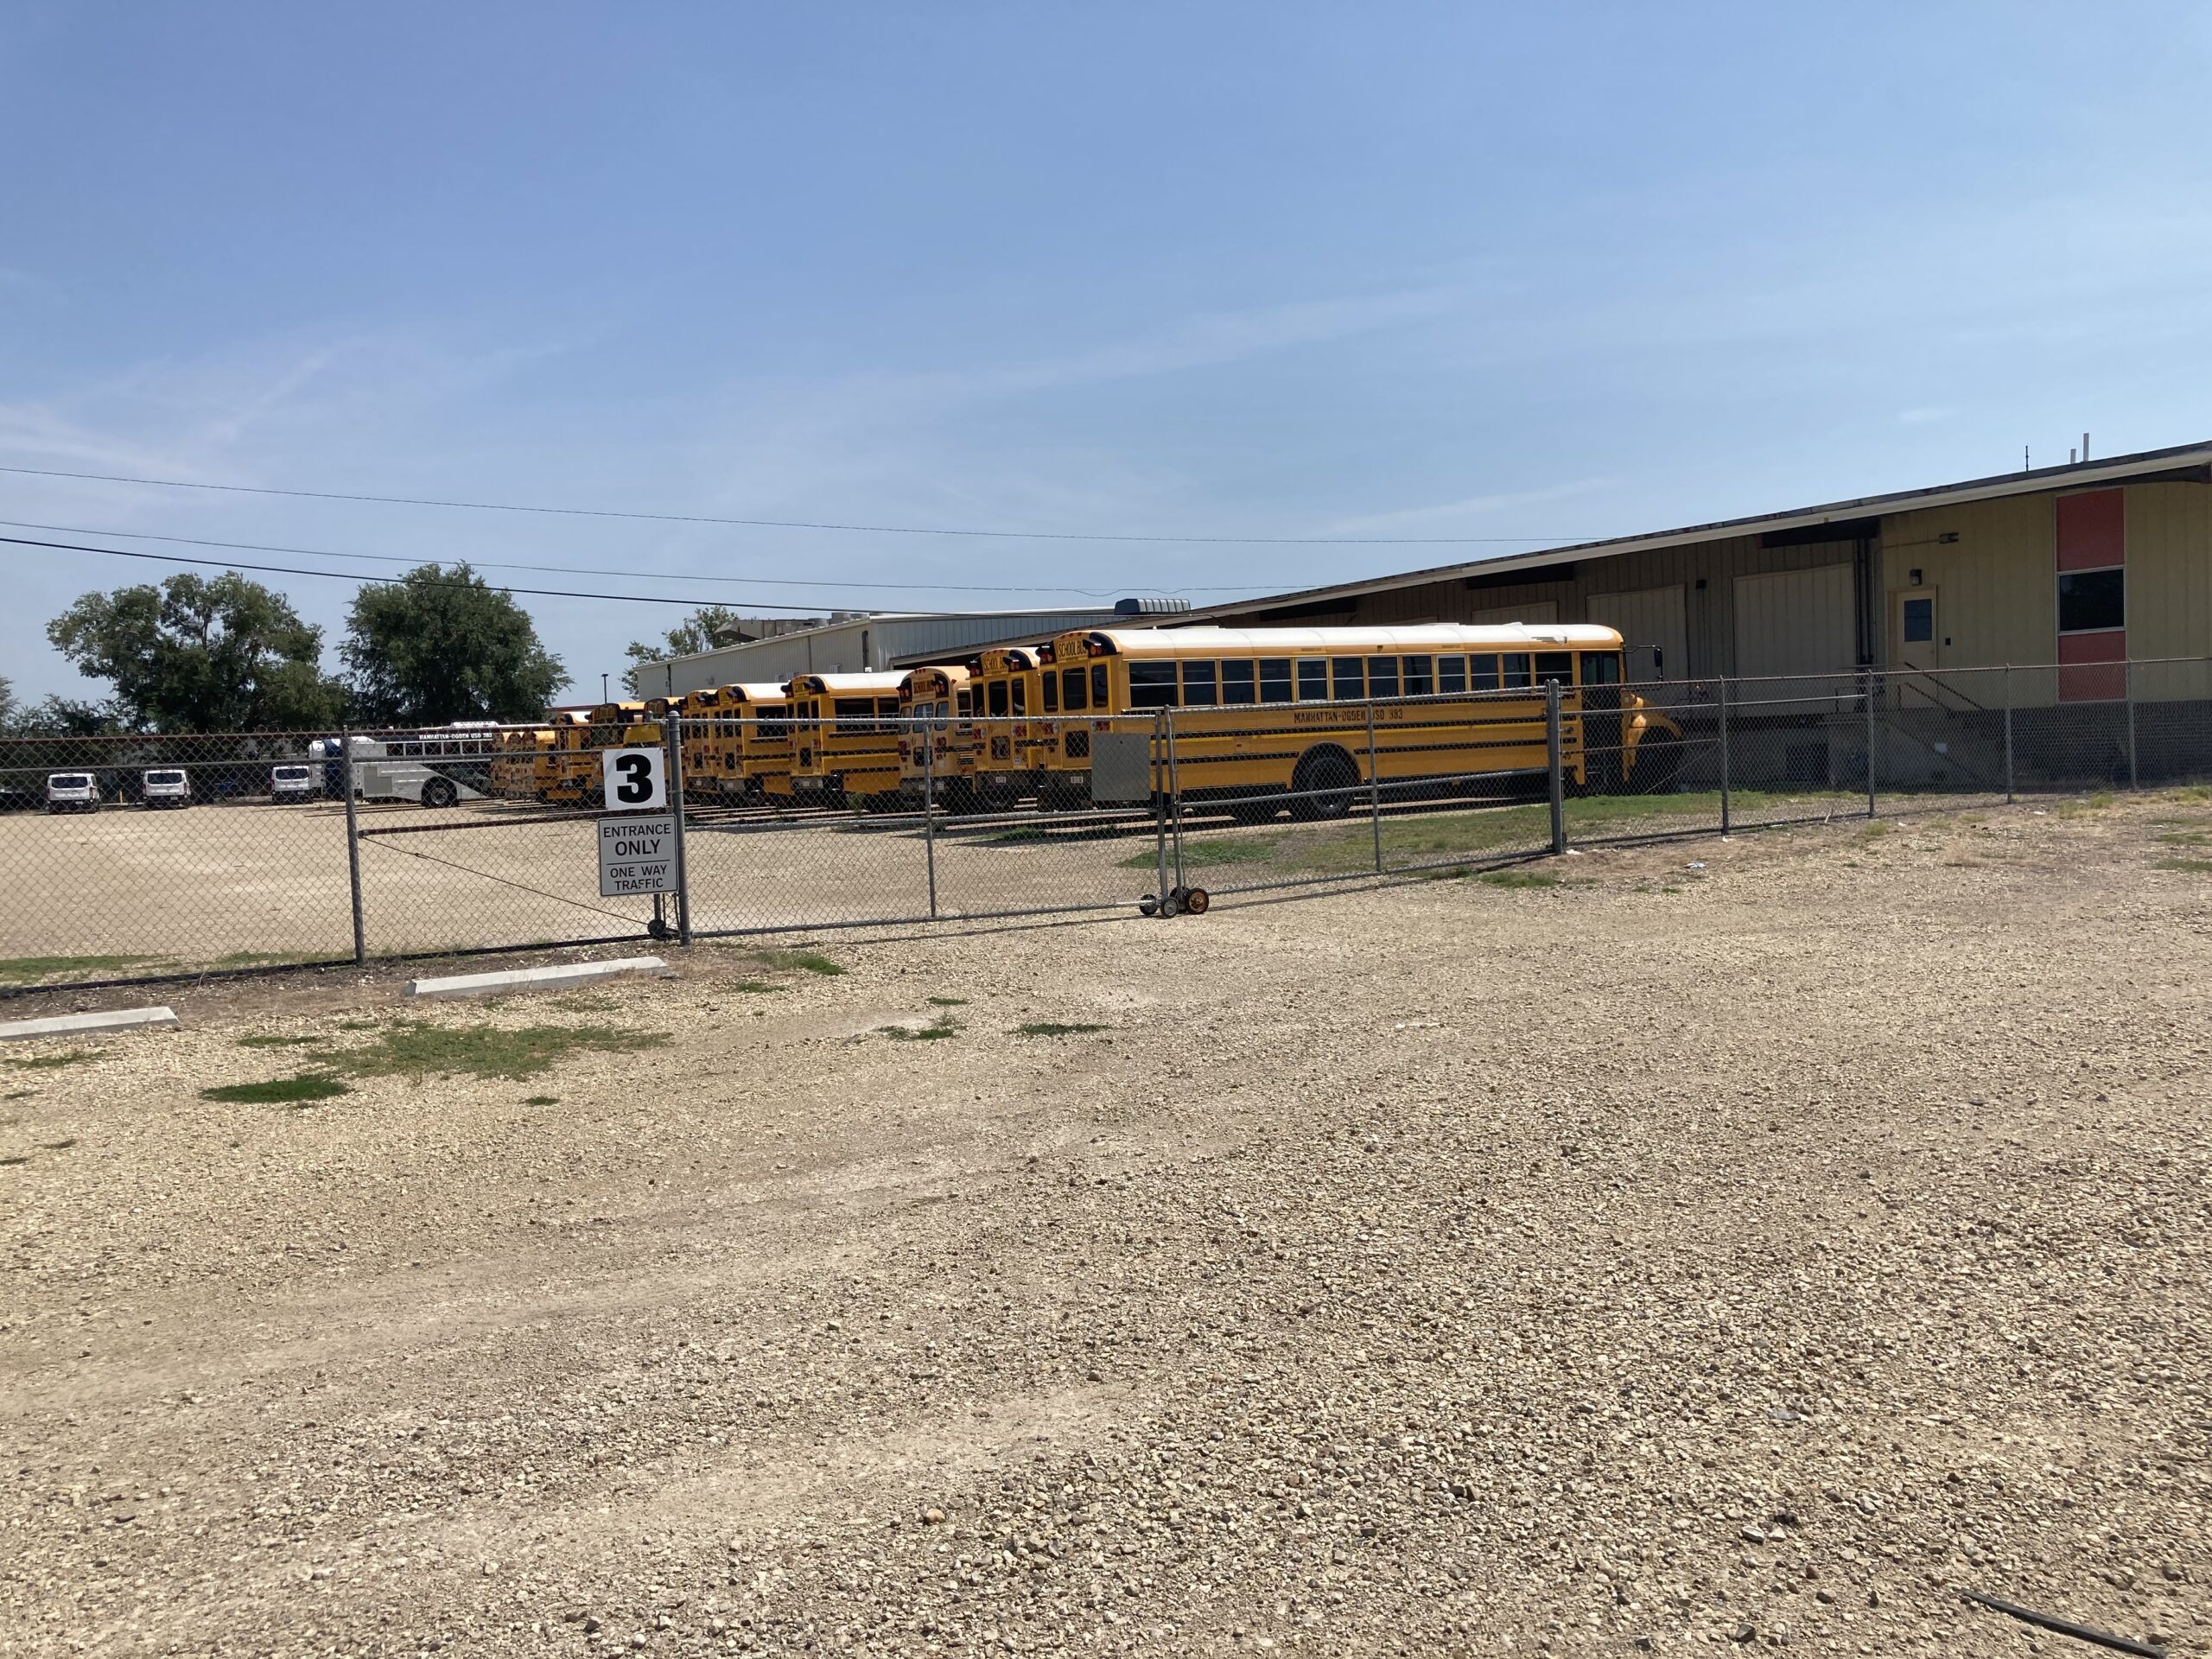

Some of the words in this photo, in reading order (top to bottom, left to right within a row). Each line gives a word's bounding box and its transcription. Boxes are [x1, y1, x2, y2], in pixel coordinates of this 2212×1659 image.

[1058, 640, 1077, 658] SCHOOL
[983, 657, 1000, 671] SCHOOL
[1294, 710, 1366, 724] MANHATTAN-OGDEN
[1389, 709, 1403, 720] 383
[616, 753, 653, 804] 3
[603, 823, 671, 838] ENTRANCE
[614, 839, 661, 856] ONLY
[610, 867, 635, 879] ONE
[641, 864, 667, 876] WAY
[614, 878, 664, 892] TRAFFIC
